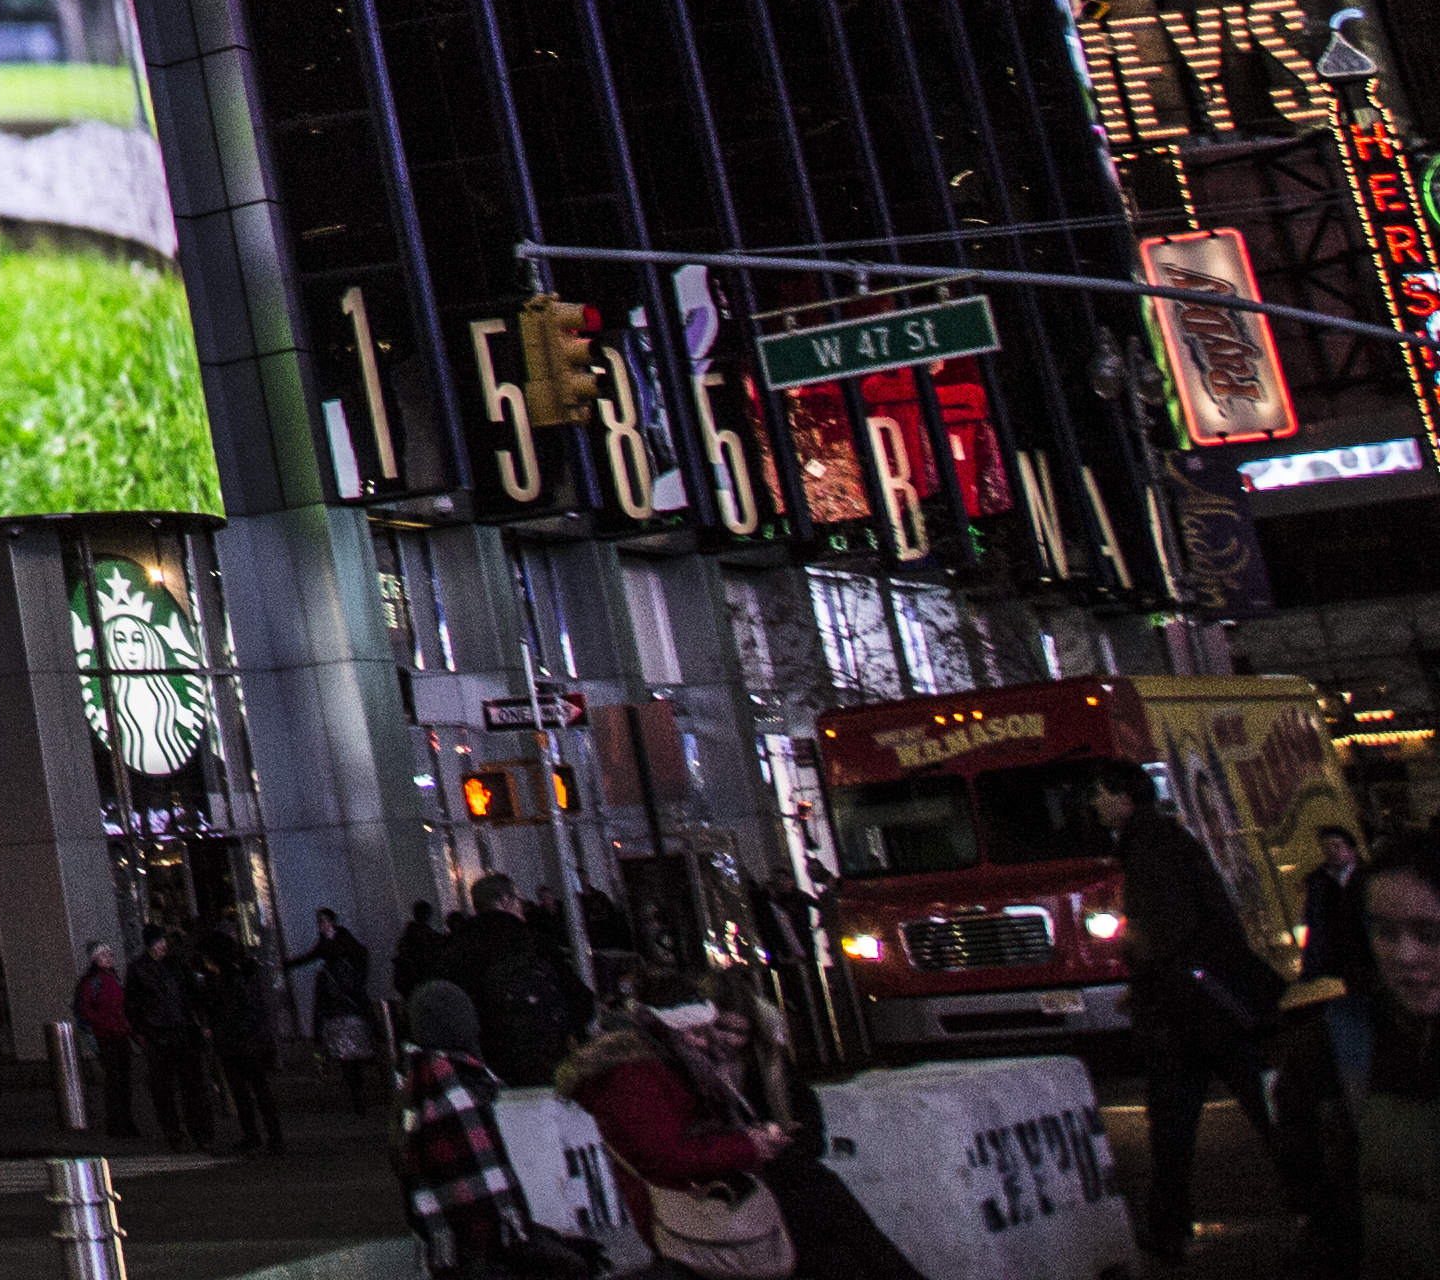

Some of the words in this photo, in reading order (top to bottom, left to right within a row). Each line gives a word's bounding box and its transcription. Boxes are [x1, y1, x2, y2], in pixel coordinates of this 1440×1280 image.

[812, 337, 842, 370] W
[857, 327, 890, 359] 47
[909, 317, 941, 352] St
[1162, 262, 1268, 402] PayDy
